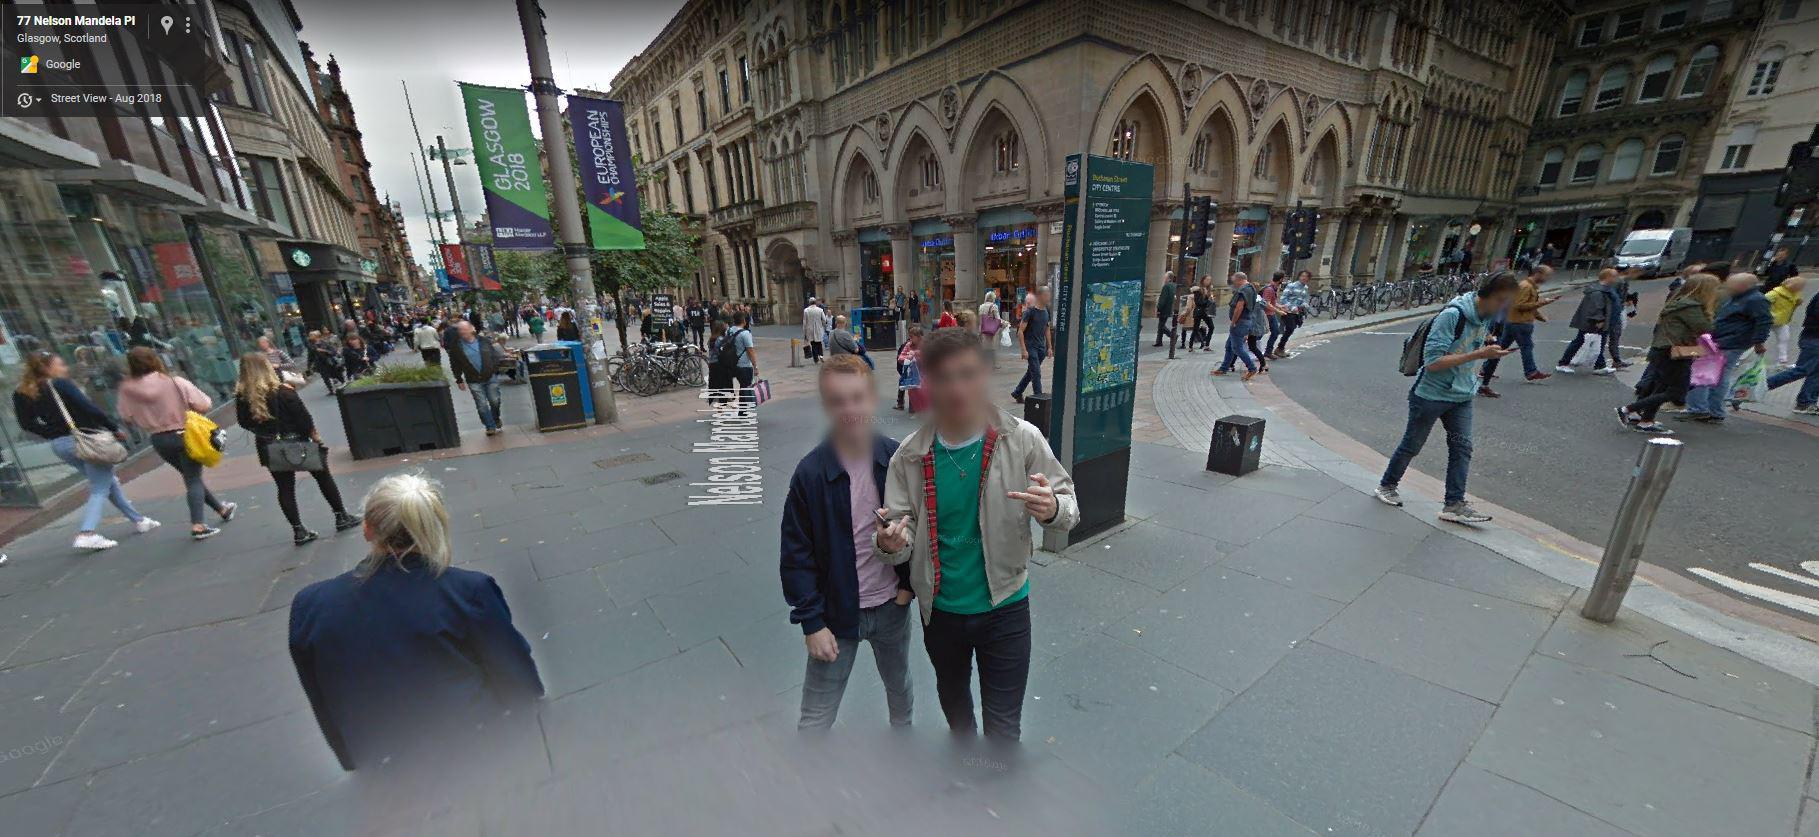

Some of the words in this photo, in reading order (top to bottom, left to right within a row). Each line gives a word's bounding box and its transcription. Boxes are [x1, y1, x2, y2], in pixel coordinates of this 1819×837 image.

[478, 98, 512, 190] GLASGOW
[507, 152, 531, 191] 2018
[587, 109, 611, 184] EUROPEAN
[599, 111, 620, 185] CHAMPIONSHIPS
[1059, 302, 1067, 332] CENTRE
